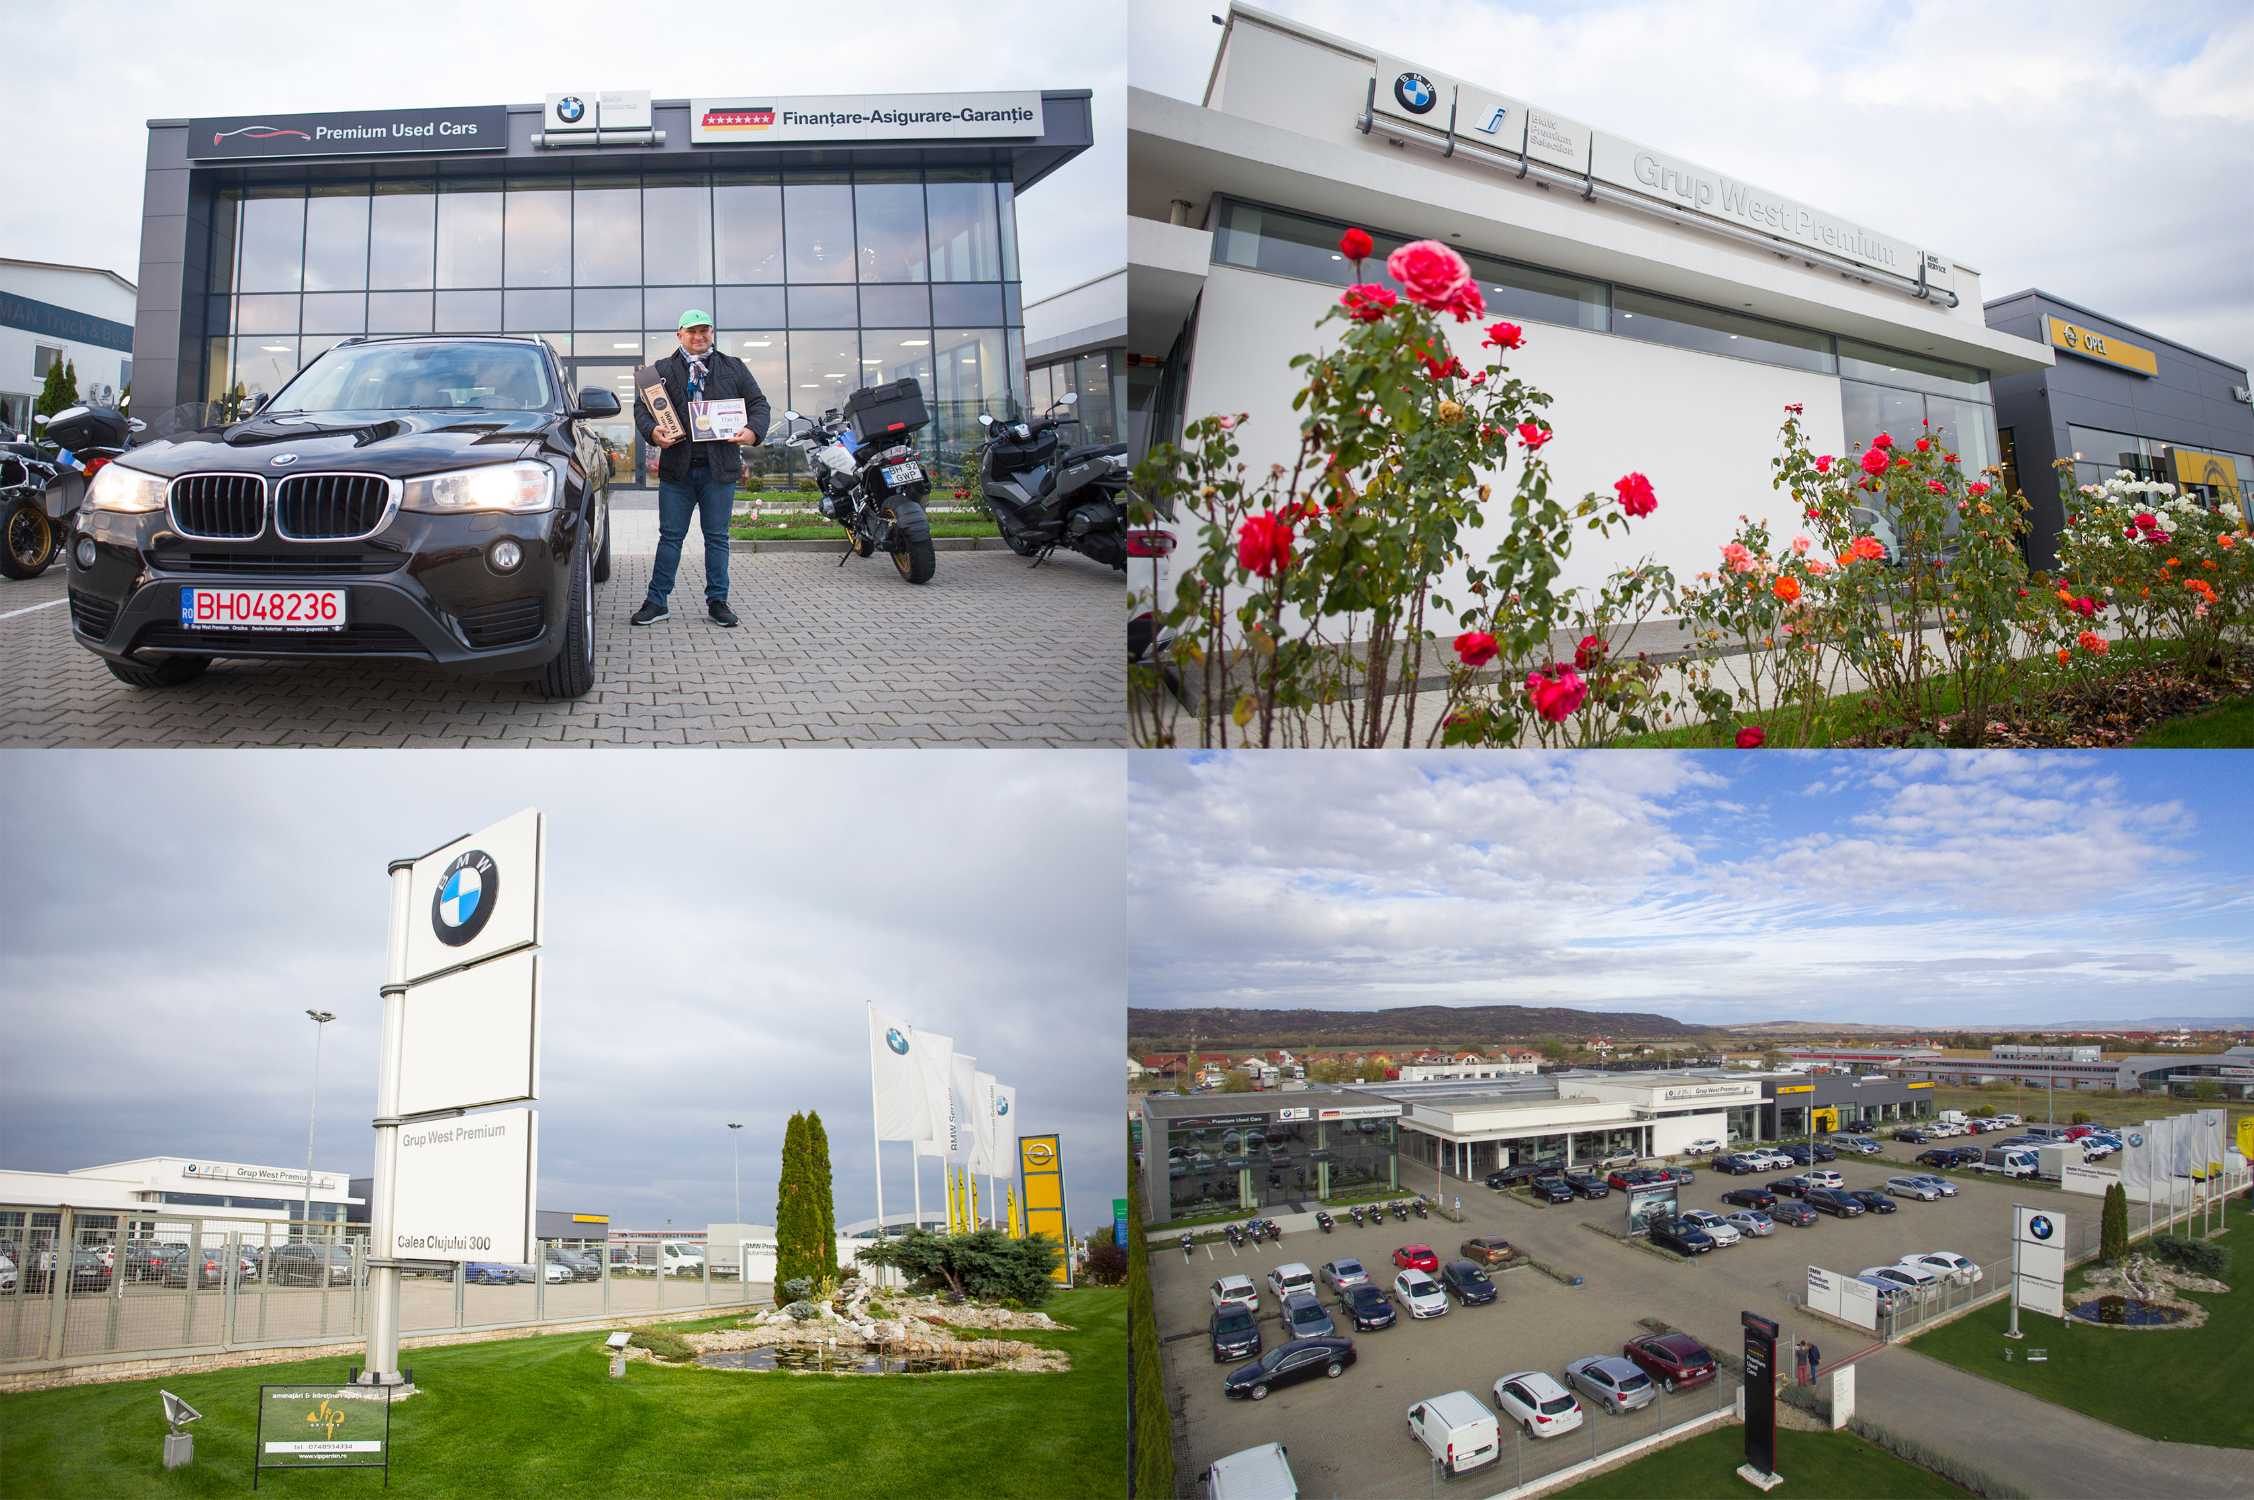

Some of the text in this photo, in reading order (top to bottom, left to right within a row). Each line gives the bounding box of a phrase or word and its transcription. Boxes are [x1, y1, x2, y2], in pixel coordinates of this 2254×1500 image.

[315, 120, 478, 140] Premium Used Cars
[1634, 151, 1898, 268] Grup West Premium
[2084, 334, 2108, 354] OPEL
[896, 470, 915, 482] GWP
[182, 593, 337, 621] RO BH048236
[403, 1124, 505, 1149] Grup West Premium
[237, 1168, 258, 1179] Grup
[259, 1169, 279, 1179] West
[397, 1235, 492, 1252] Calea Clujului 300
[1808, 1267, 1822, 1276] BMW
